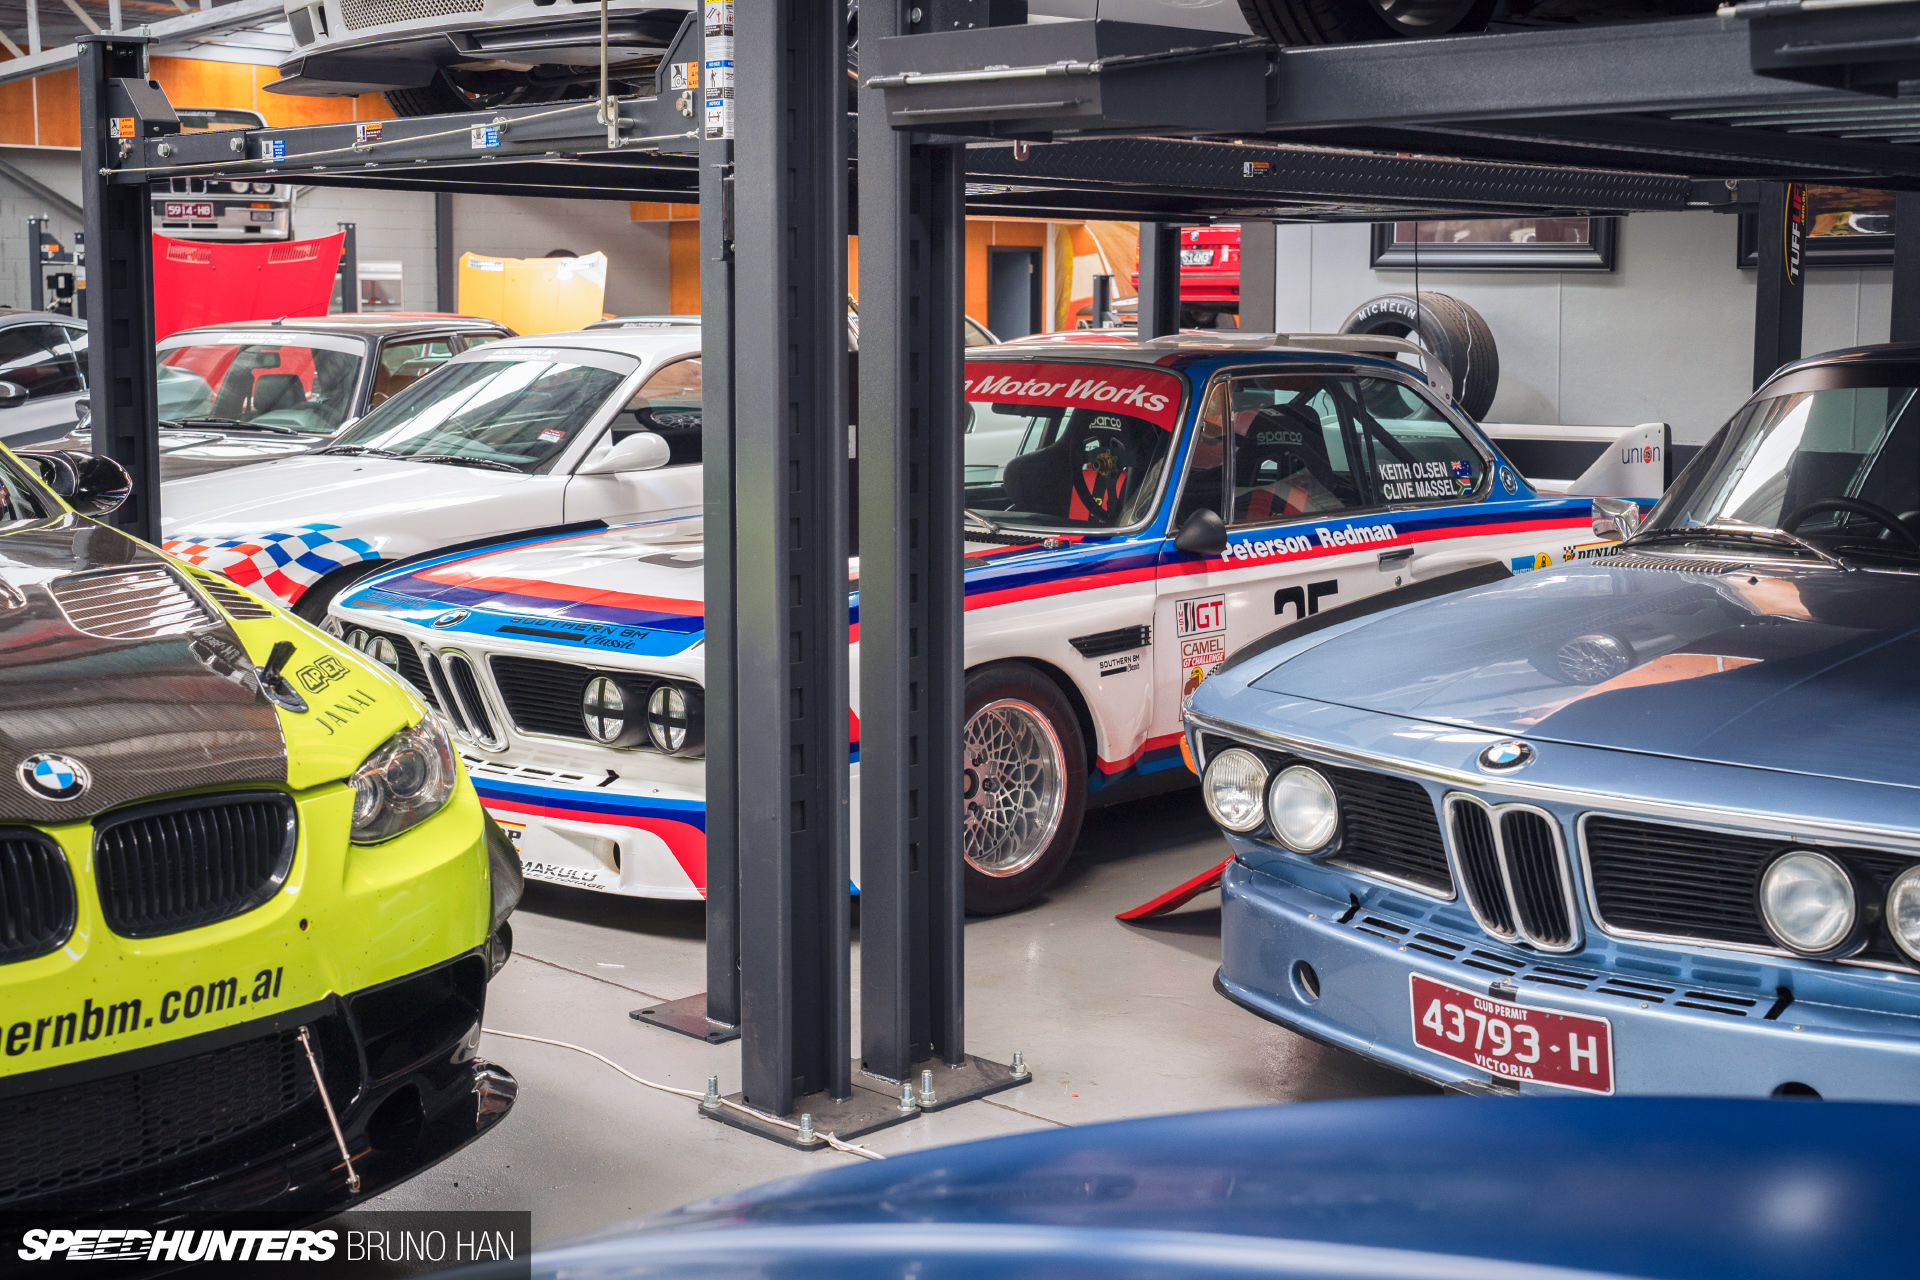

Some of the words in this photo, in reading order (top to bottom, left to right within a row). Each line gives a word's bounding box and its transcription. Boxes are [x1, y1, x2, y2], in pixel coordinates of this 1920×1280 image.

[1791, 184, 1802, 276] TUFFLIF
[1358, 302, 1416, 321] MICHELIN
[972, 375, 1066, 397] Motor
[1065, 378, 1170, 412] Works
[1257, 431, 1302, 445] sparco
[1379, 463, 1412, 480] KEITH
[1413, 462, 1448, 479] OLSEN
[1383, 482, 1415, 500] CLIVE
[1415, 479, 1457, 497] MASSEL
[1221, 535, 1312, 563] Peterson
[1315, 524, 1397, 549] Redman
[1578, 545, 1620, 559] DUNLO
[1196, 600, 1223, 629] GT
[509, 616, 617, 635] SOUTHERN
[618, 628, 650, 640] BM
[583, 634, 636, 649] Classic
[1183, 639, 1223, 656] CAMEL
[1100, 656, 1132, 669] SOUTHERN
[1133, 654, 1139, 662] BM
[1184, 658, 1191, 667] GT
[1192, 653, 1224, 666] CHALLENGE
[297, 655, 350, 694] APEX
[316, 689, 376, 735] JANAI
[0, 966, 284, 1056] ernbm.com.a
[1474, 997, 1494, 1013] CLUB
[1495, 1004, 1527, 1021] PERMIT
[1474, 1053, 1534, 1079] VICTORIA
